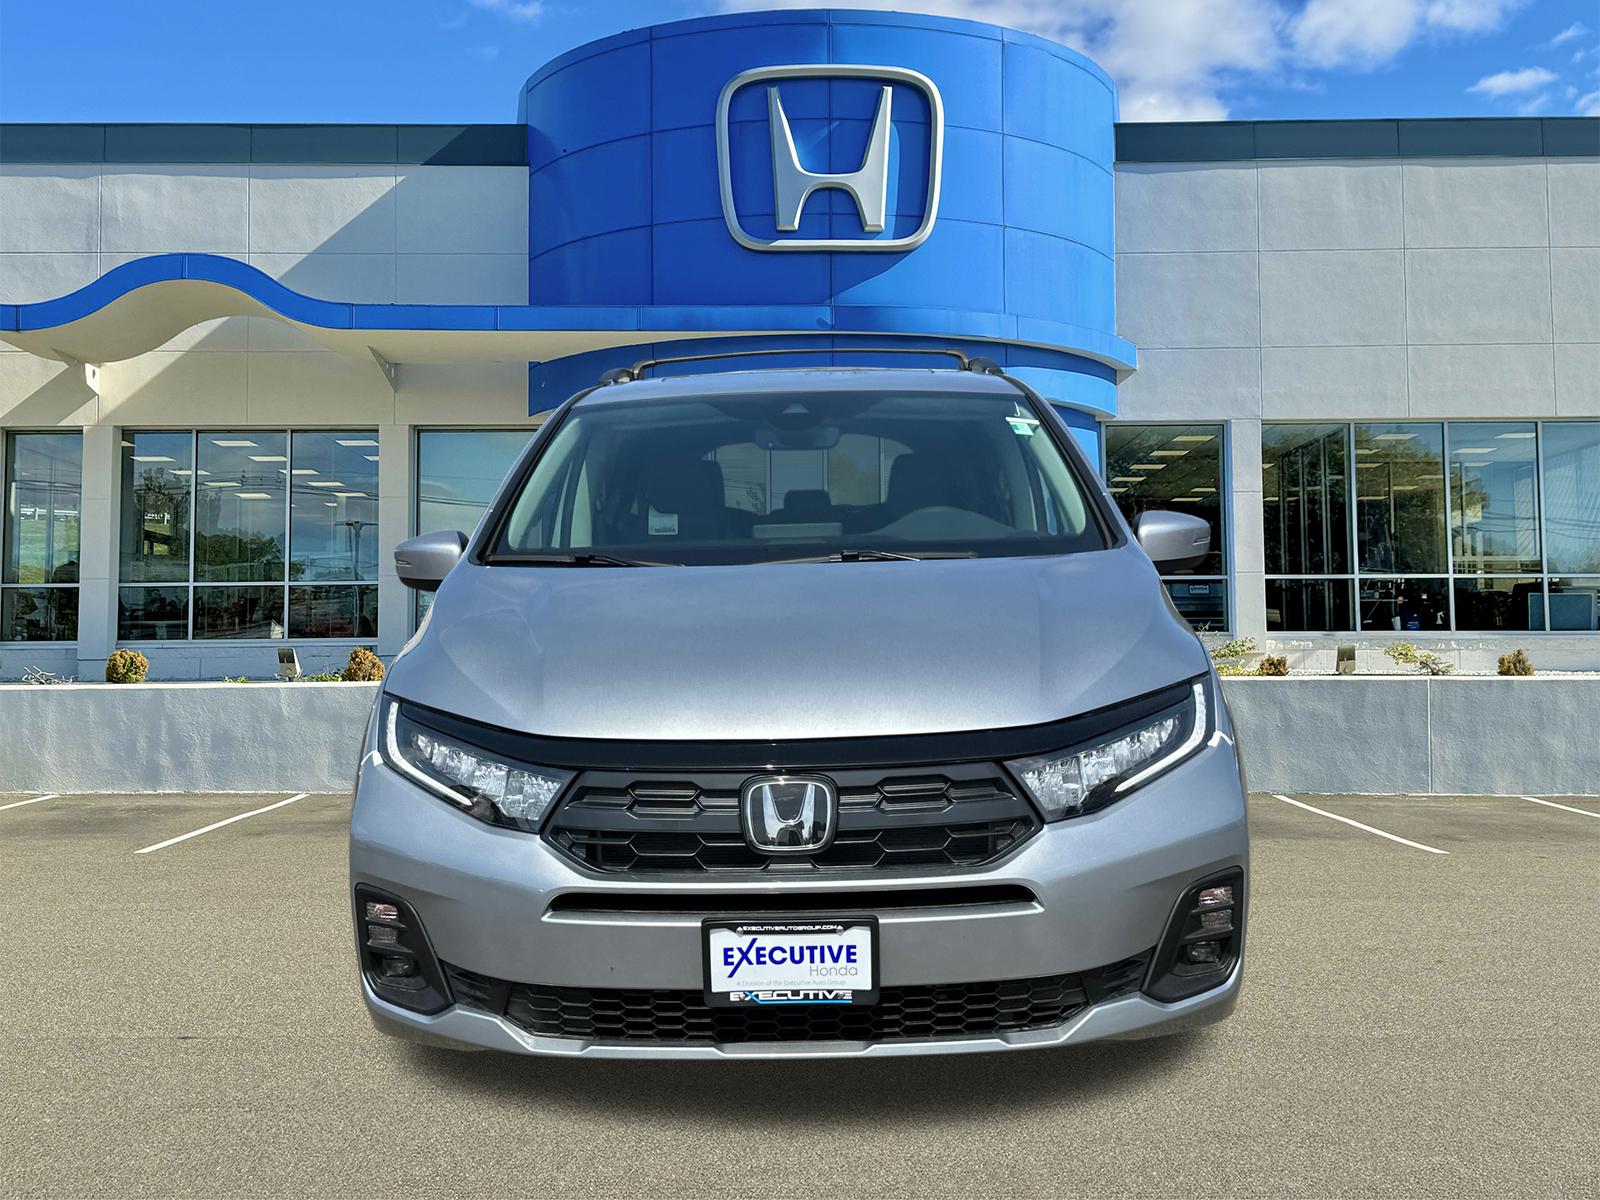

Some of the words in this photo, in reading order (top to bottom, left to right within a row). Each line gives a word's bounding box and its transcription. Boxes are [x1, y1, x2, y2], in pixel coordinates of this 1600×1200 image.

[723, 937, 857, 978] EXECUTIVE
[809, 965, 858, 976] Honda
[729, 990, 853, 1003] EXECUTIVE
